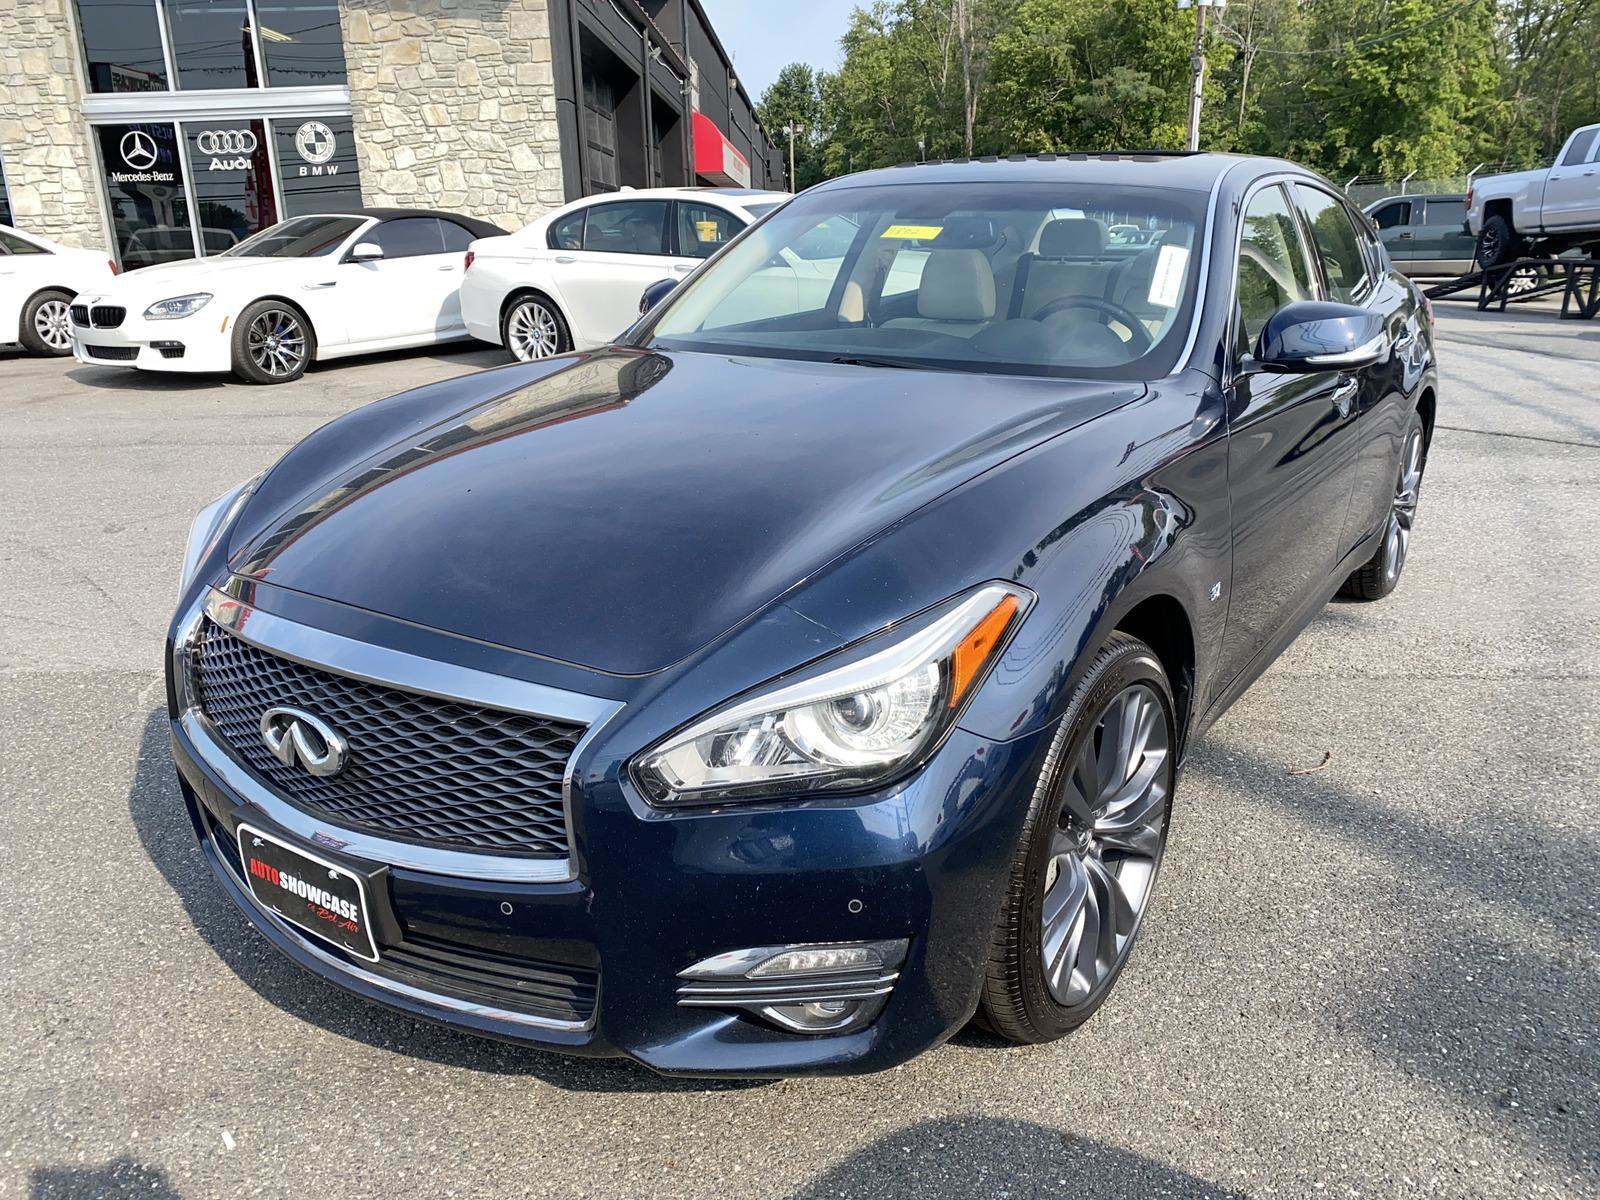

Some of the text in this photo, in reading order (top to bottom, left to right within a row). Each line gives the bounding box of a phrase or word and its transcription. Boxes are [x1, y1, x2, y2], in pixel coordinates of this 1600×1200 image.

[209, 156, 253, 171] Audi
[299, 165, 339, 176] BMW
[112, 171, 174, 182] Mercedes-Benz
